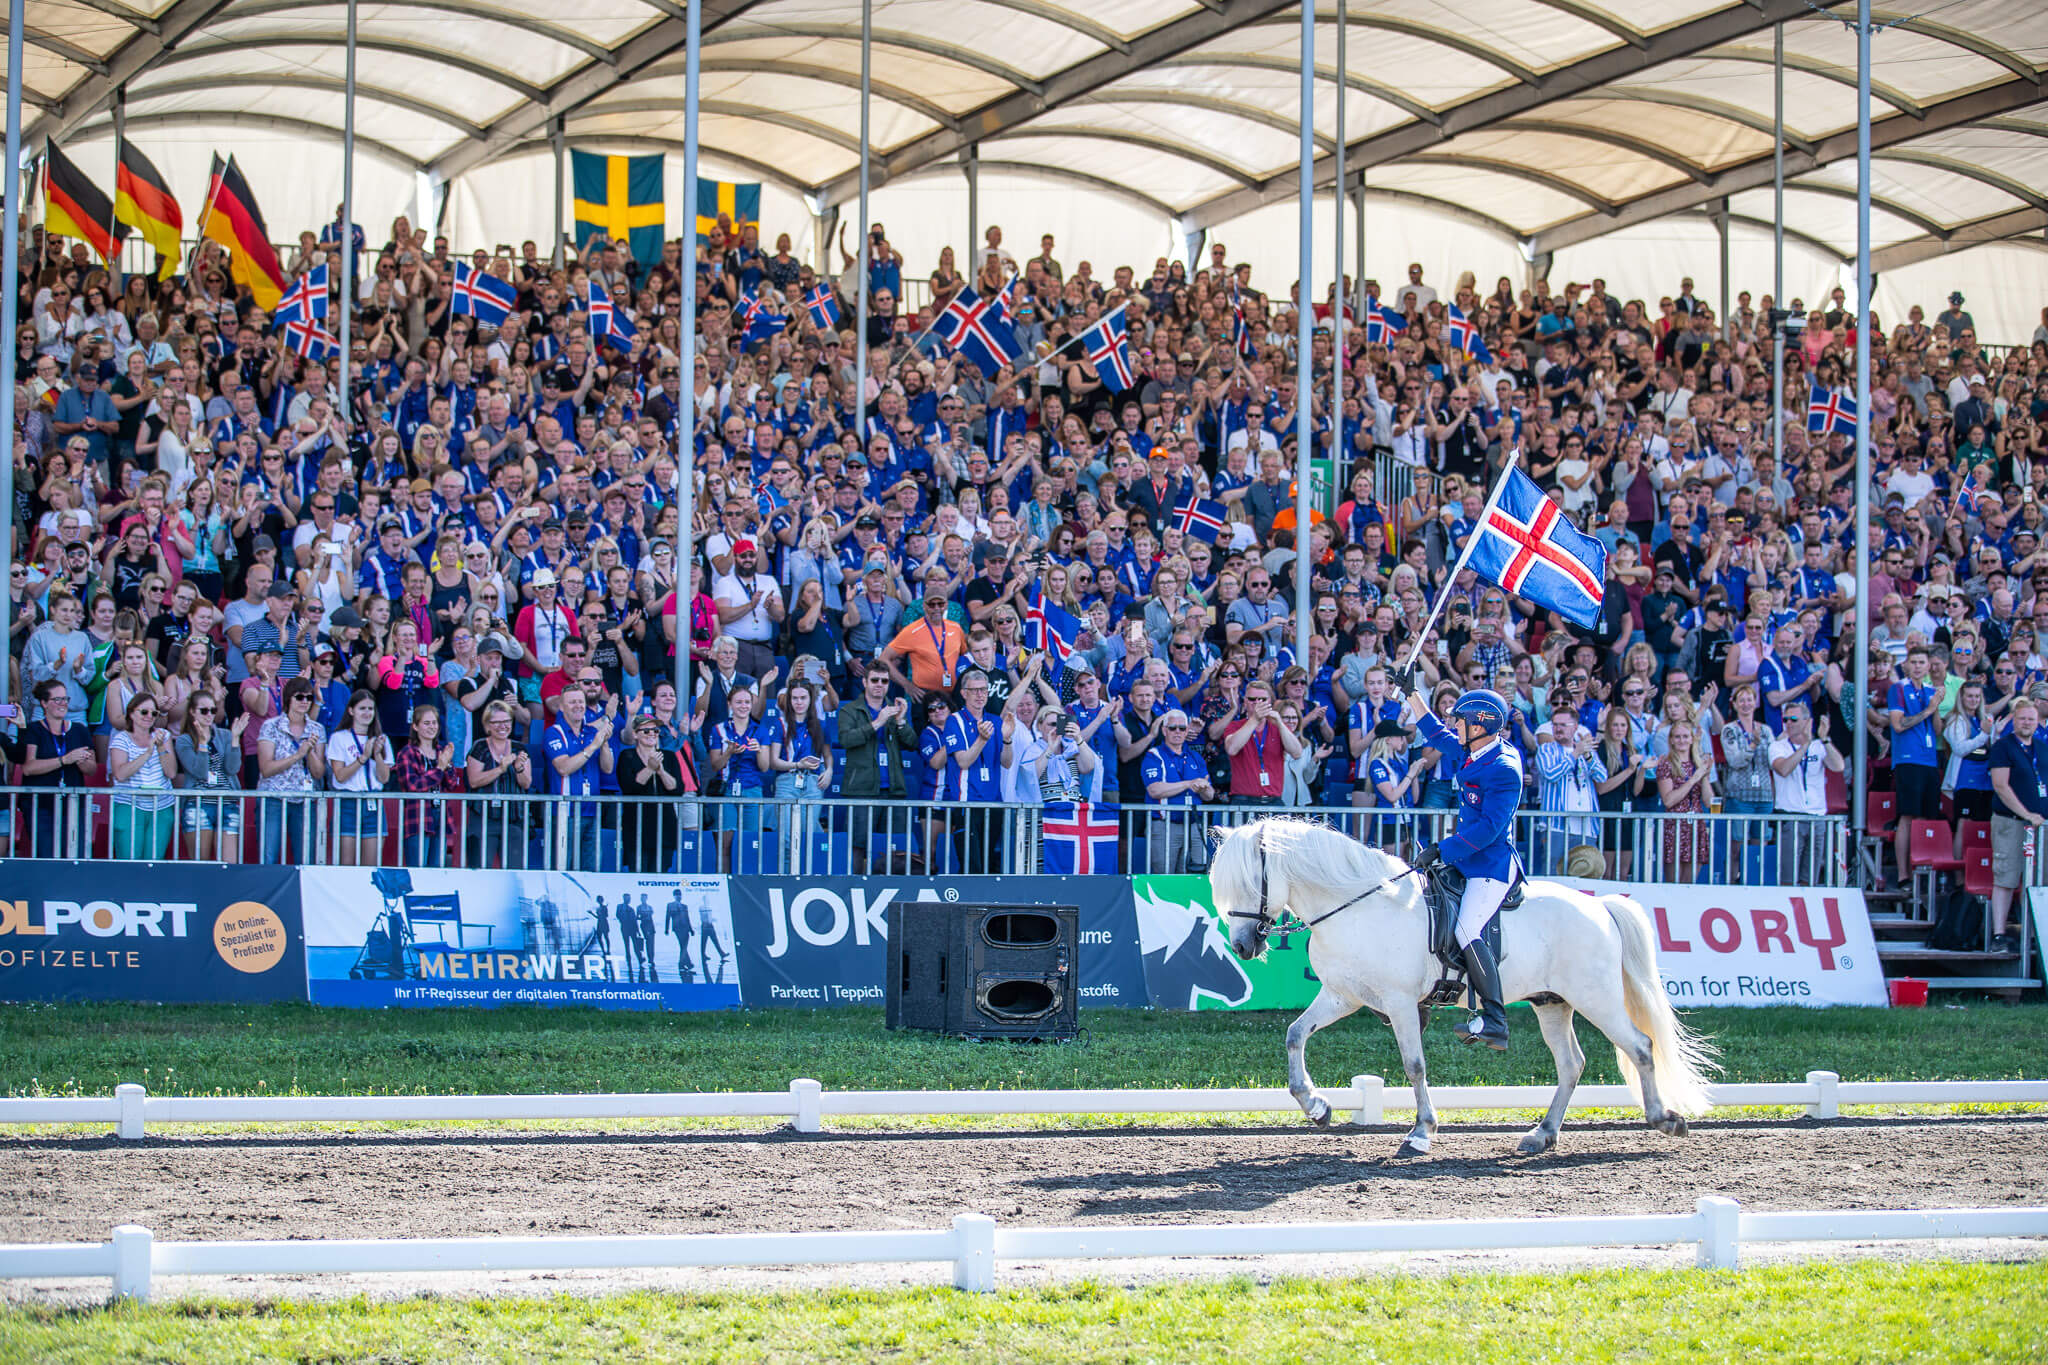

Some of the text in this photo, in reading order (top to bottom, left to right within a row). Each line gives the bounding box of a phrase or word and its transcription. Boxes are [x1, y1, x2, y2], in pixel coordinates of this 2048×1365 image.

[223, 916, 269, 932] Ihr Online-
[220, 928, 277, 947] Spezialist für
[233, 943, 275, 958] Profizelte
[394, 987, 411, 999] Ihr
[414, 987, 489, 1001] IT-Regisseur
[492, 988, 513, 999] der
[516, 988, 568, 1001] digitalen
[770, 985, 884, 1002] Parkett Teppich
[1701, 976, 1730, 996] for
[1737, 976, 1811, 996] Riders
